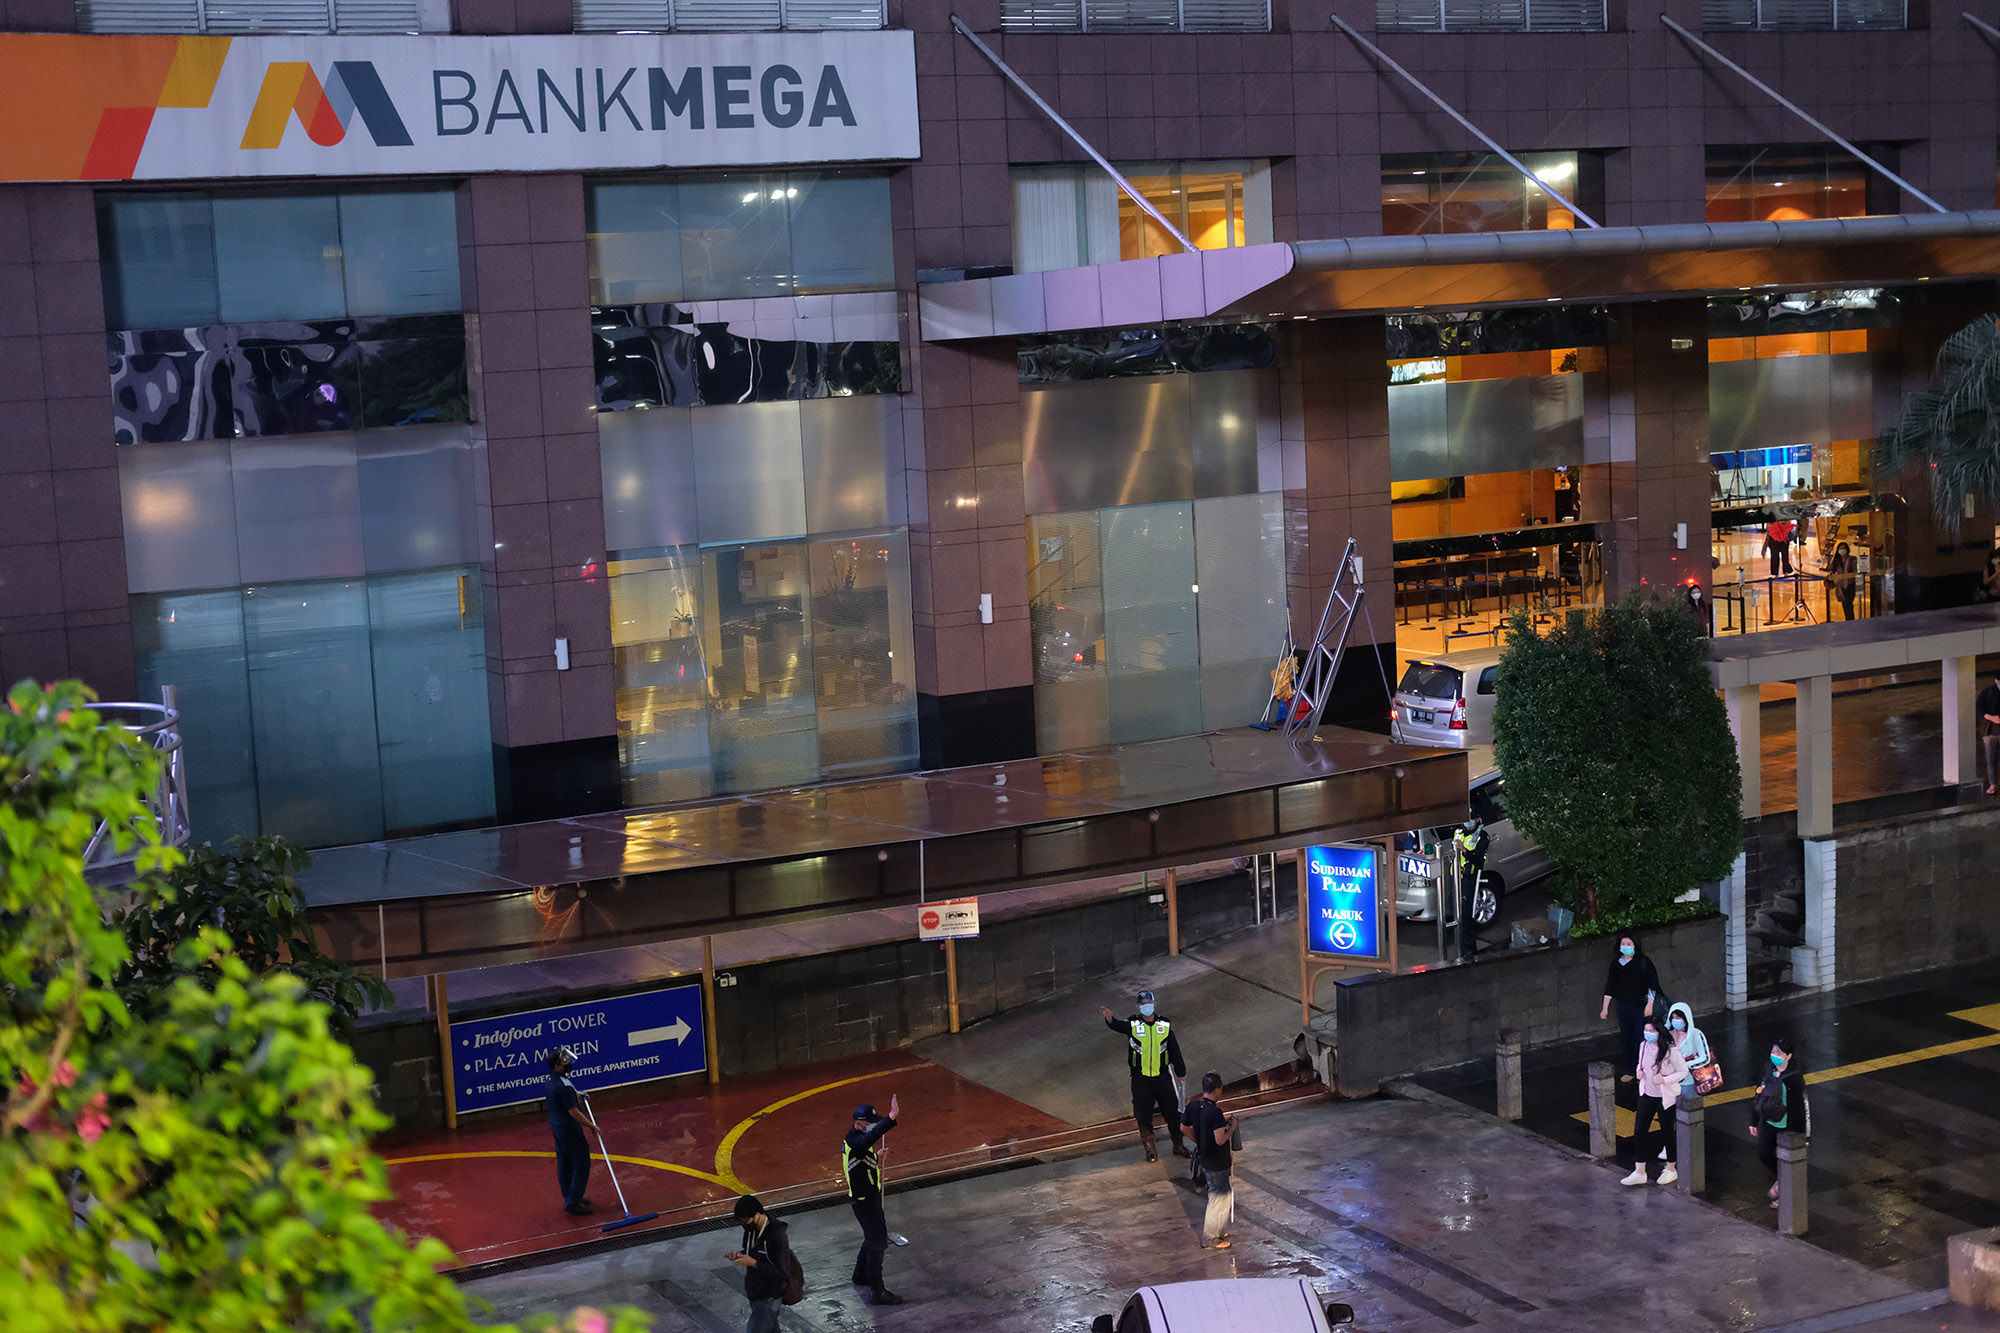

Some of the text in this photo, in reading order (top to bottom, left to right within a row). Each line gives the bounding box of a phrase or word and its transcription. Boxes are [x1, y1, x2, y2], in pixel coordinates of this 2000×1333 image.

[1400, 857, 1431, 878] TAXI
[1322, 908, 1364, 921] MASUK
[473, 1012, 607, 1049] Indofood TOWER
[474, 1053, 529, 1073] PLAZA
[476, 1083, 495, 1094] THE
[602, 1055, 660, 1073] APARTMENTS
